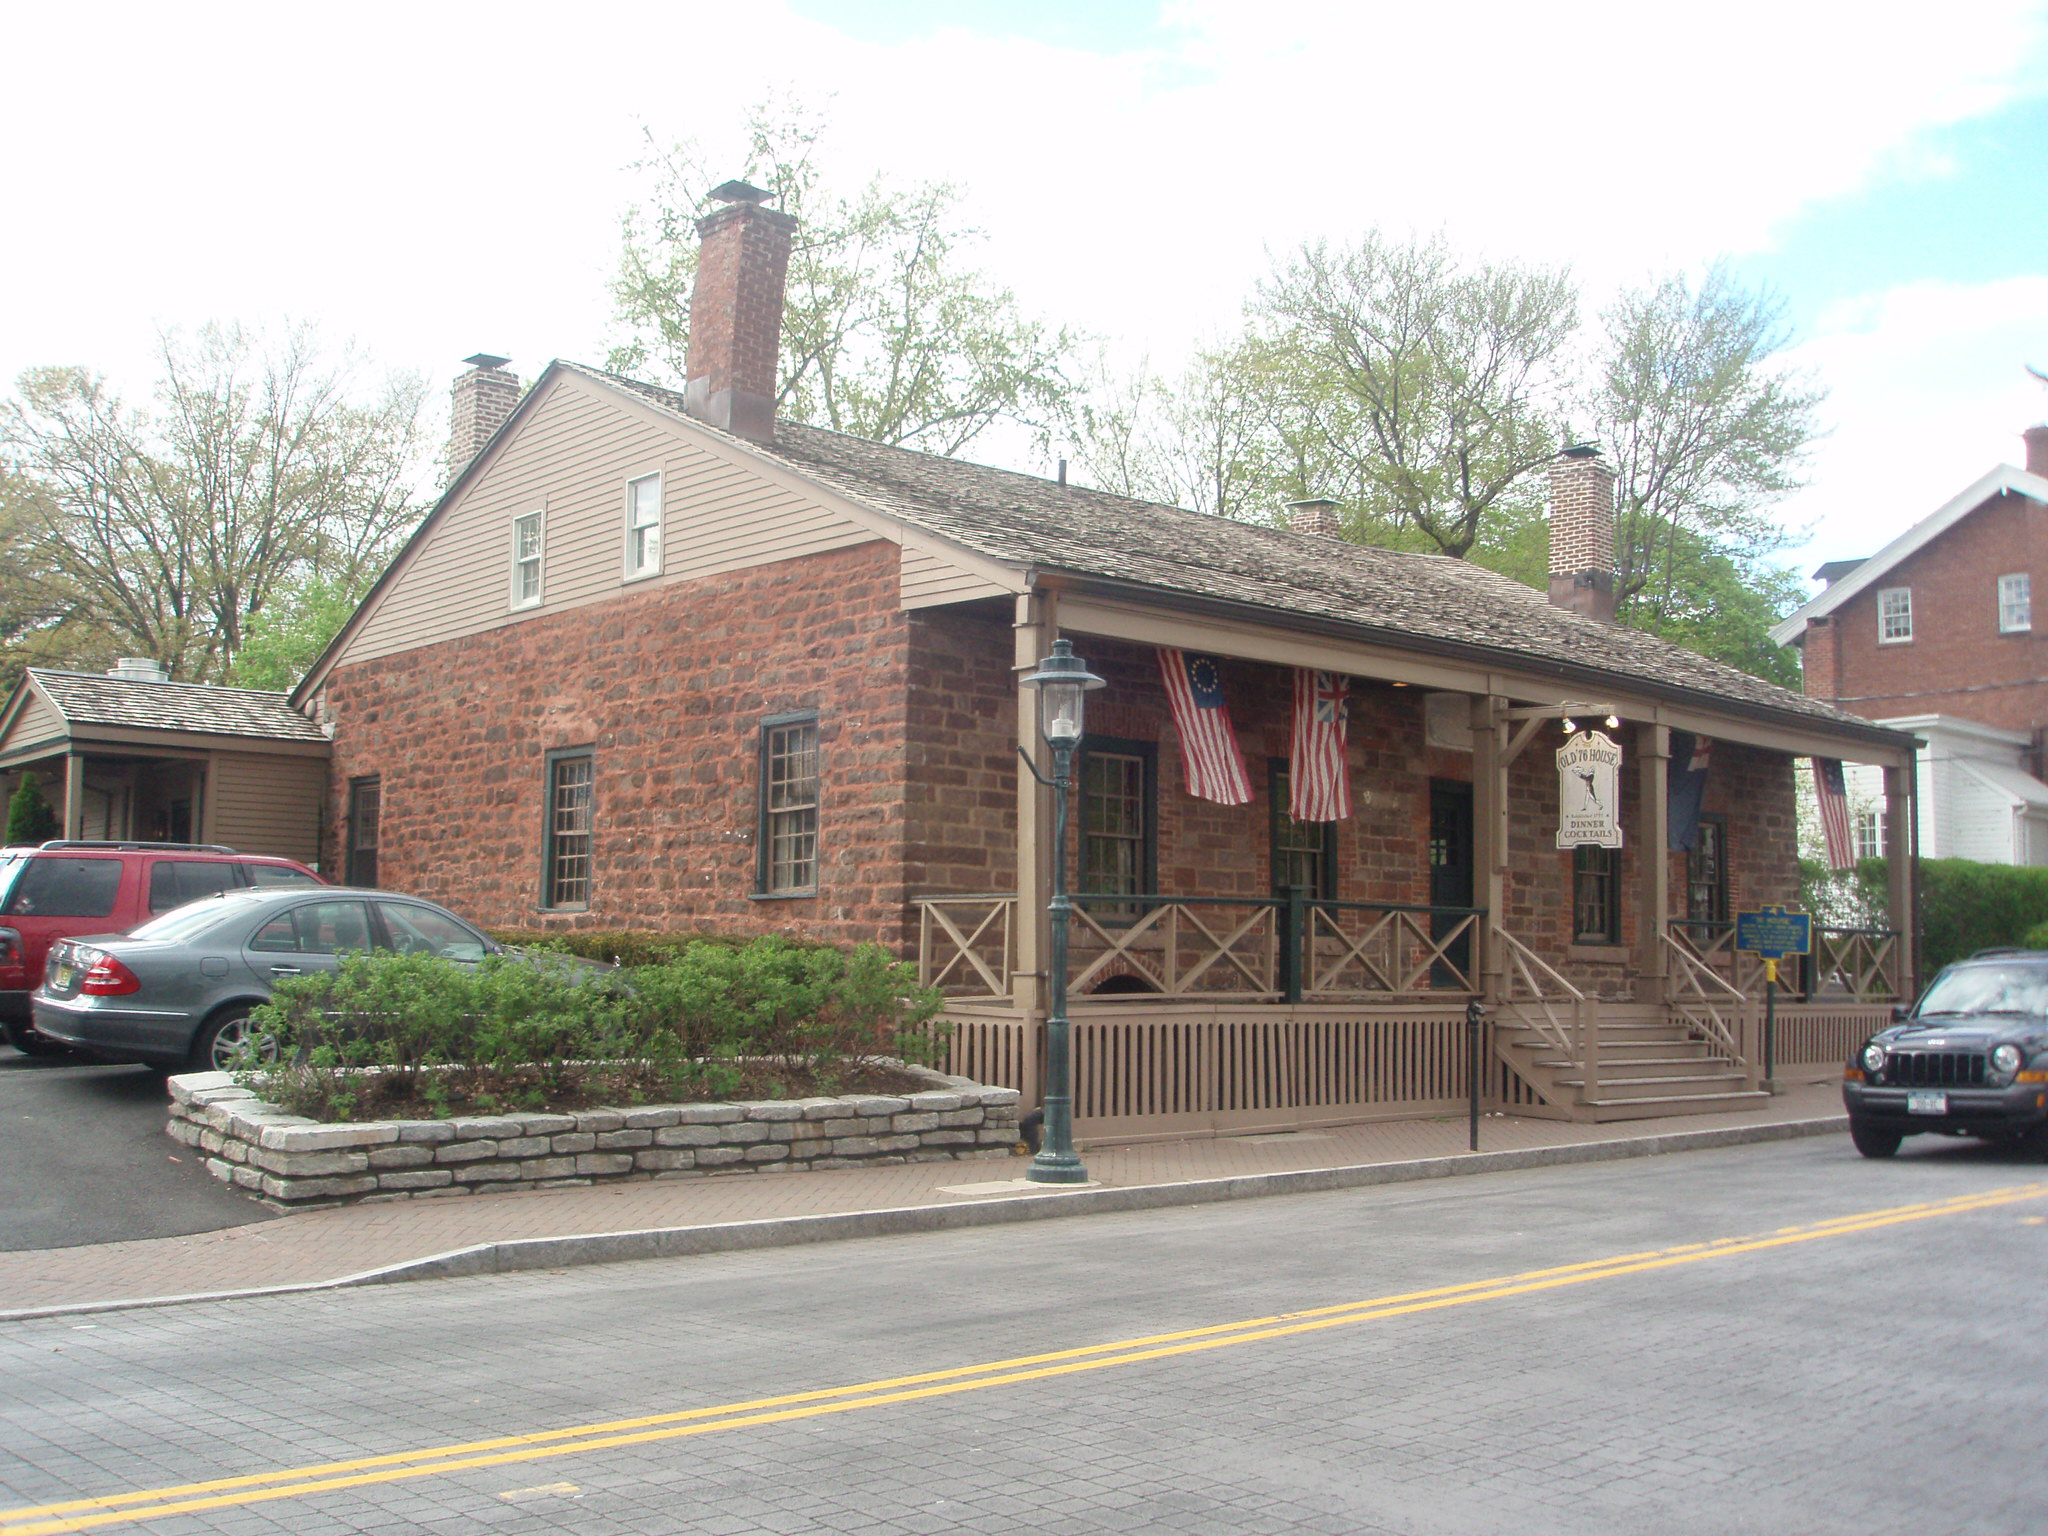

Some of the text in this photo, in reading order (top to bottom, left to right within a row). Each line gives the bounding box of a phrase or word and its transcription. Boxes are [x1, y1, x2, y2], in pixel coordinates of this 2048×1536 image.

[1560, 752, 1576, 768] OLD
[1590, 749, 1616, 766] HOUSE
[1570, 820, 1605, 829] DINNER
[1564, 830, 1613, 839] COCKTAILS
